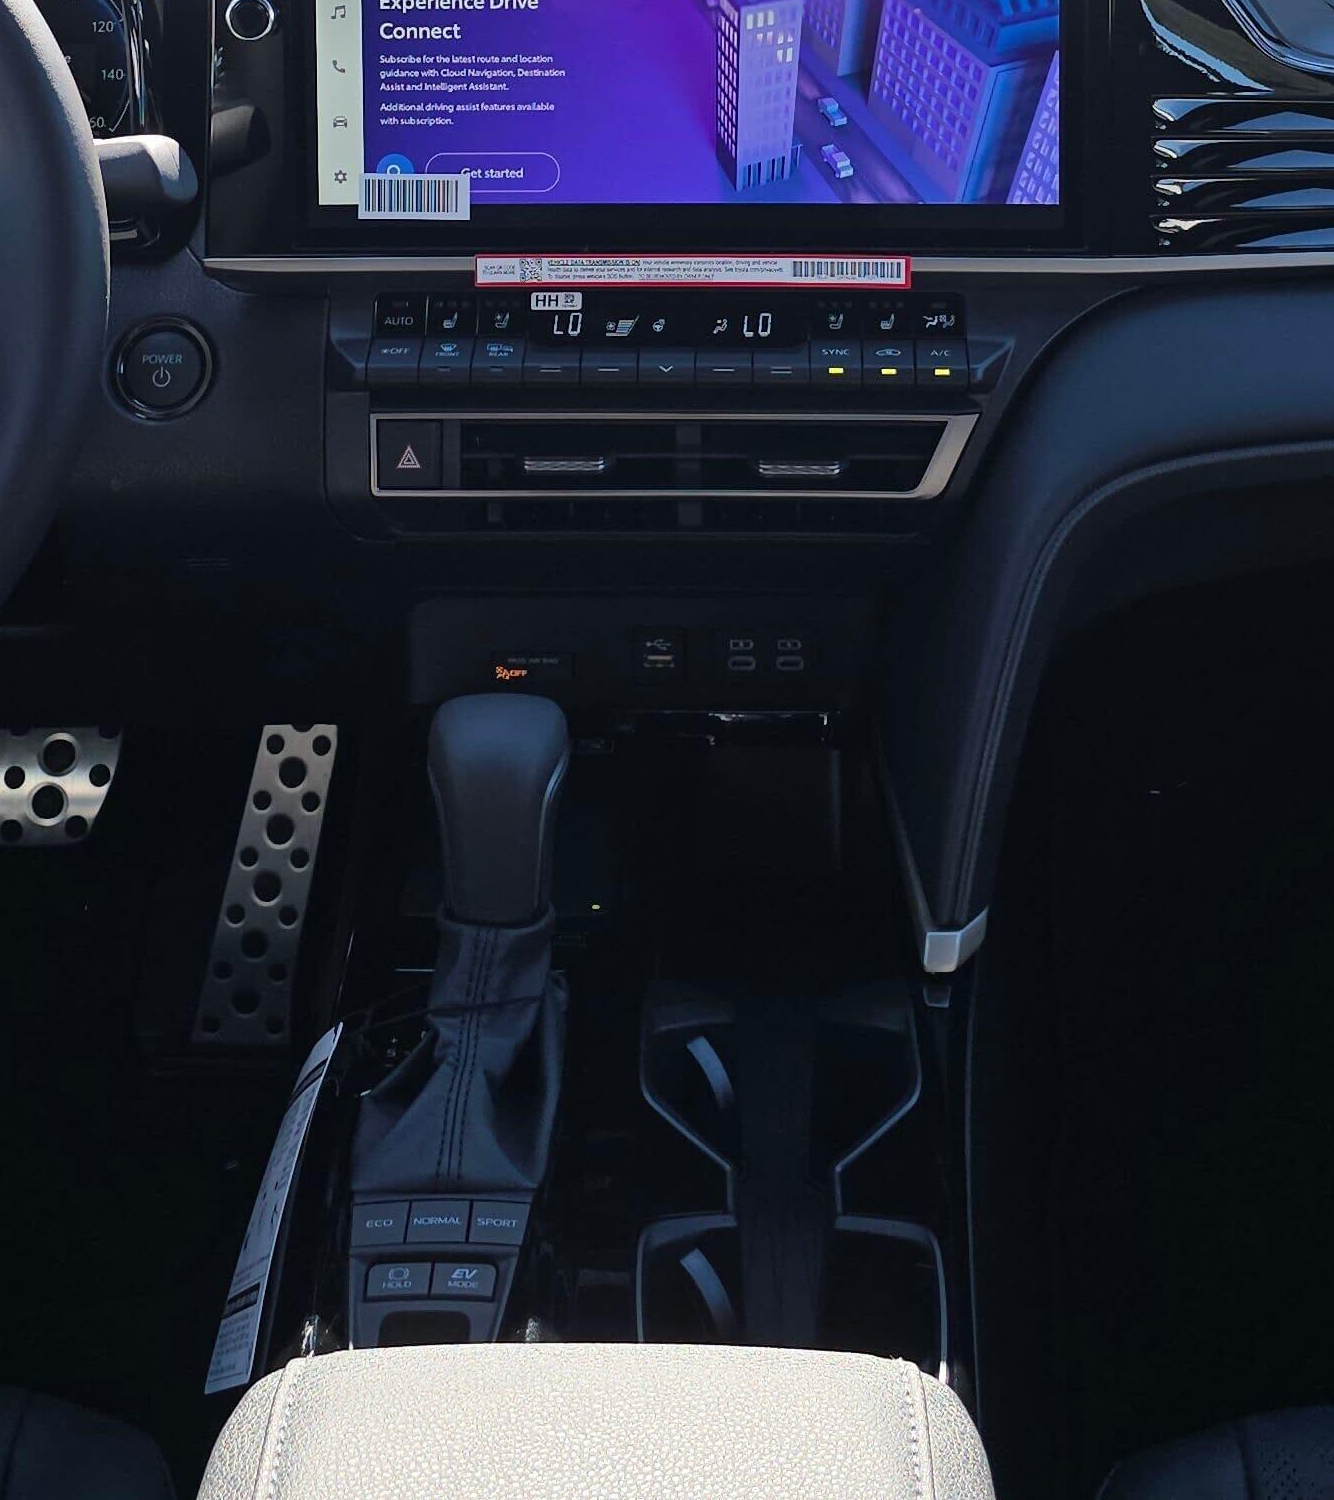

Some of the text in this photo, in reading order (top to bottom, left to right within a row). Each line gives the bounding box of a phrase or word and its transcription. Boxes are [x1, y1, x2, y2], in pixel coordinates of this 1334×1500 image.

[92, 21, 114, 33] 120
[379, 23, 461, 39] Connect
[380, 55, 553, 64] Subscribe for the latest route and location
[101, 68, 124, 81] 140
[380, 69, 566, 79] guidance with Cloud Navigation, Destination
[380, 83, 509, 92] Assist and Intelligent Assistant.
[380, 102, 555, 113] Additional driving assist features available
[380, 117, 454, 126] with subscription.
[484, 167, 524, 179] started
[535, 295, 559, 307] HH
[384, 316, 413, 326] AUTO
[142, 354, 183, 364] POWER
[366, 1219, 393, 1228] ECO
[413, 1217, 460, 1226] NORMAL
[477, 1218, 518, 1228] SPORT
[451, 1268, 478, 1279] EV
[382, 1281, 412, 1289] HOLD
[447, 1281, 479, 1289] MODE
